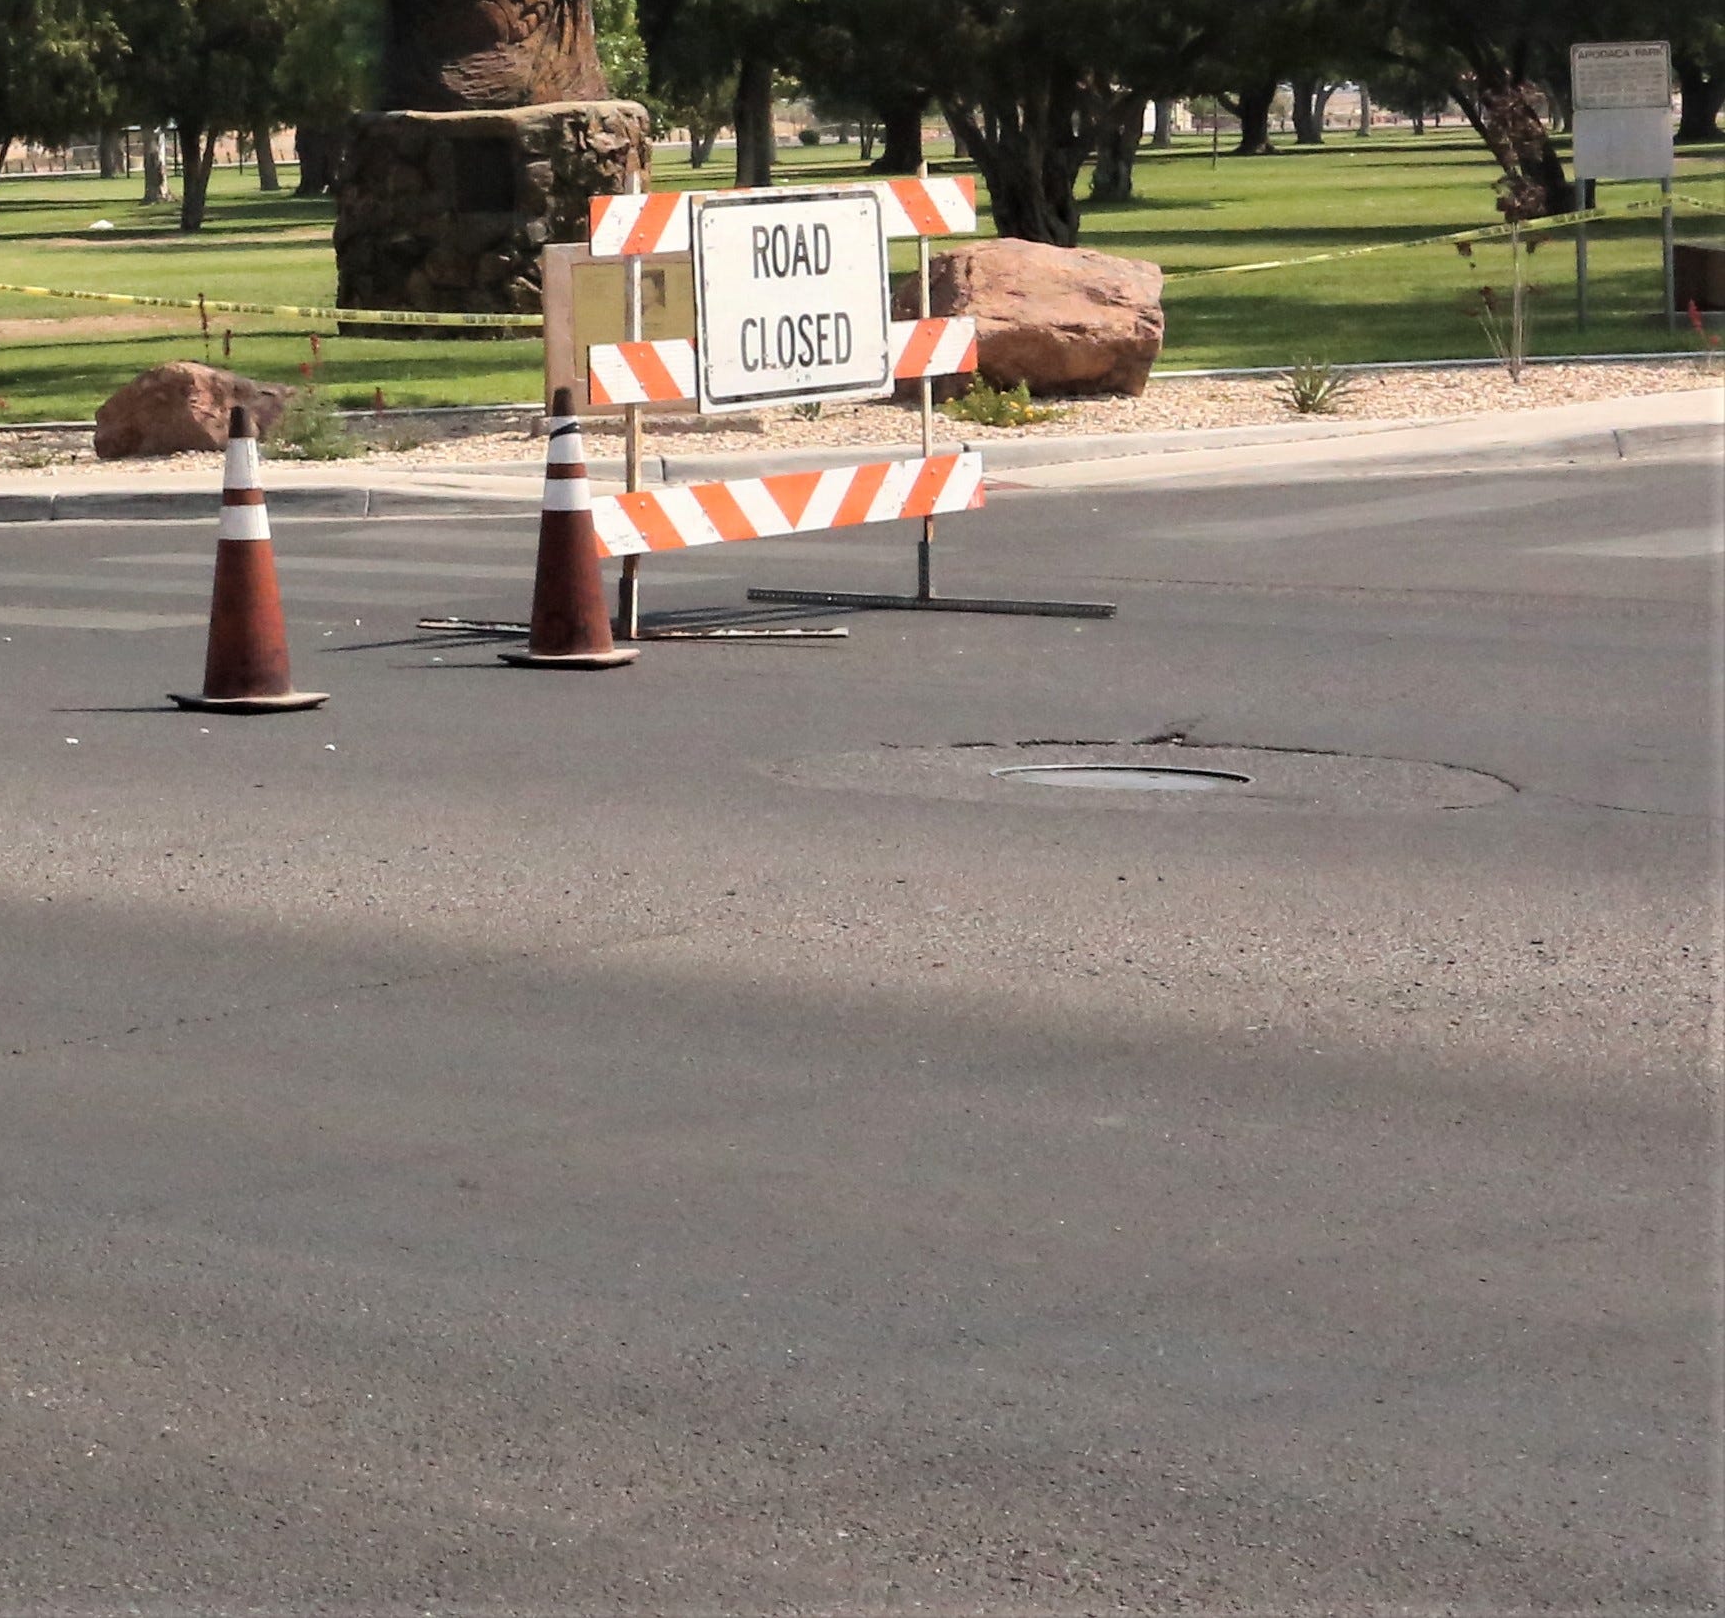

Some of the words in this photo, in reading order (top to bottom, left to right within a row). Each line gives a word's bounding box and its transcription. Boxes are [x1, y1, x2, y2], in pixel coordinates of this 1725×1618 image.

[1577, 48, 1630, 60] APODACA
[752, 223, 832, 279] ROAD
[741, 312, 853, 372] CLOSED
